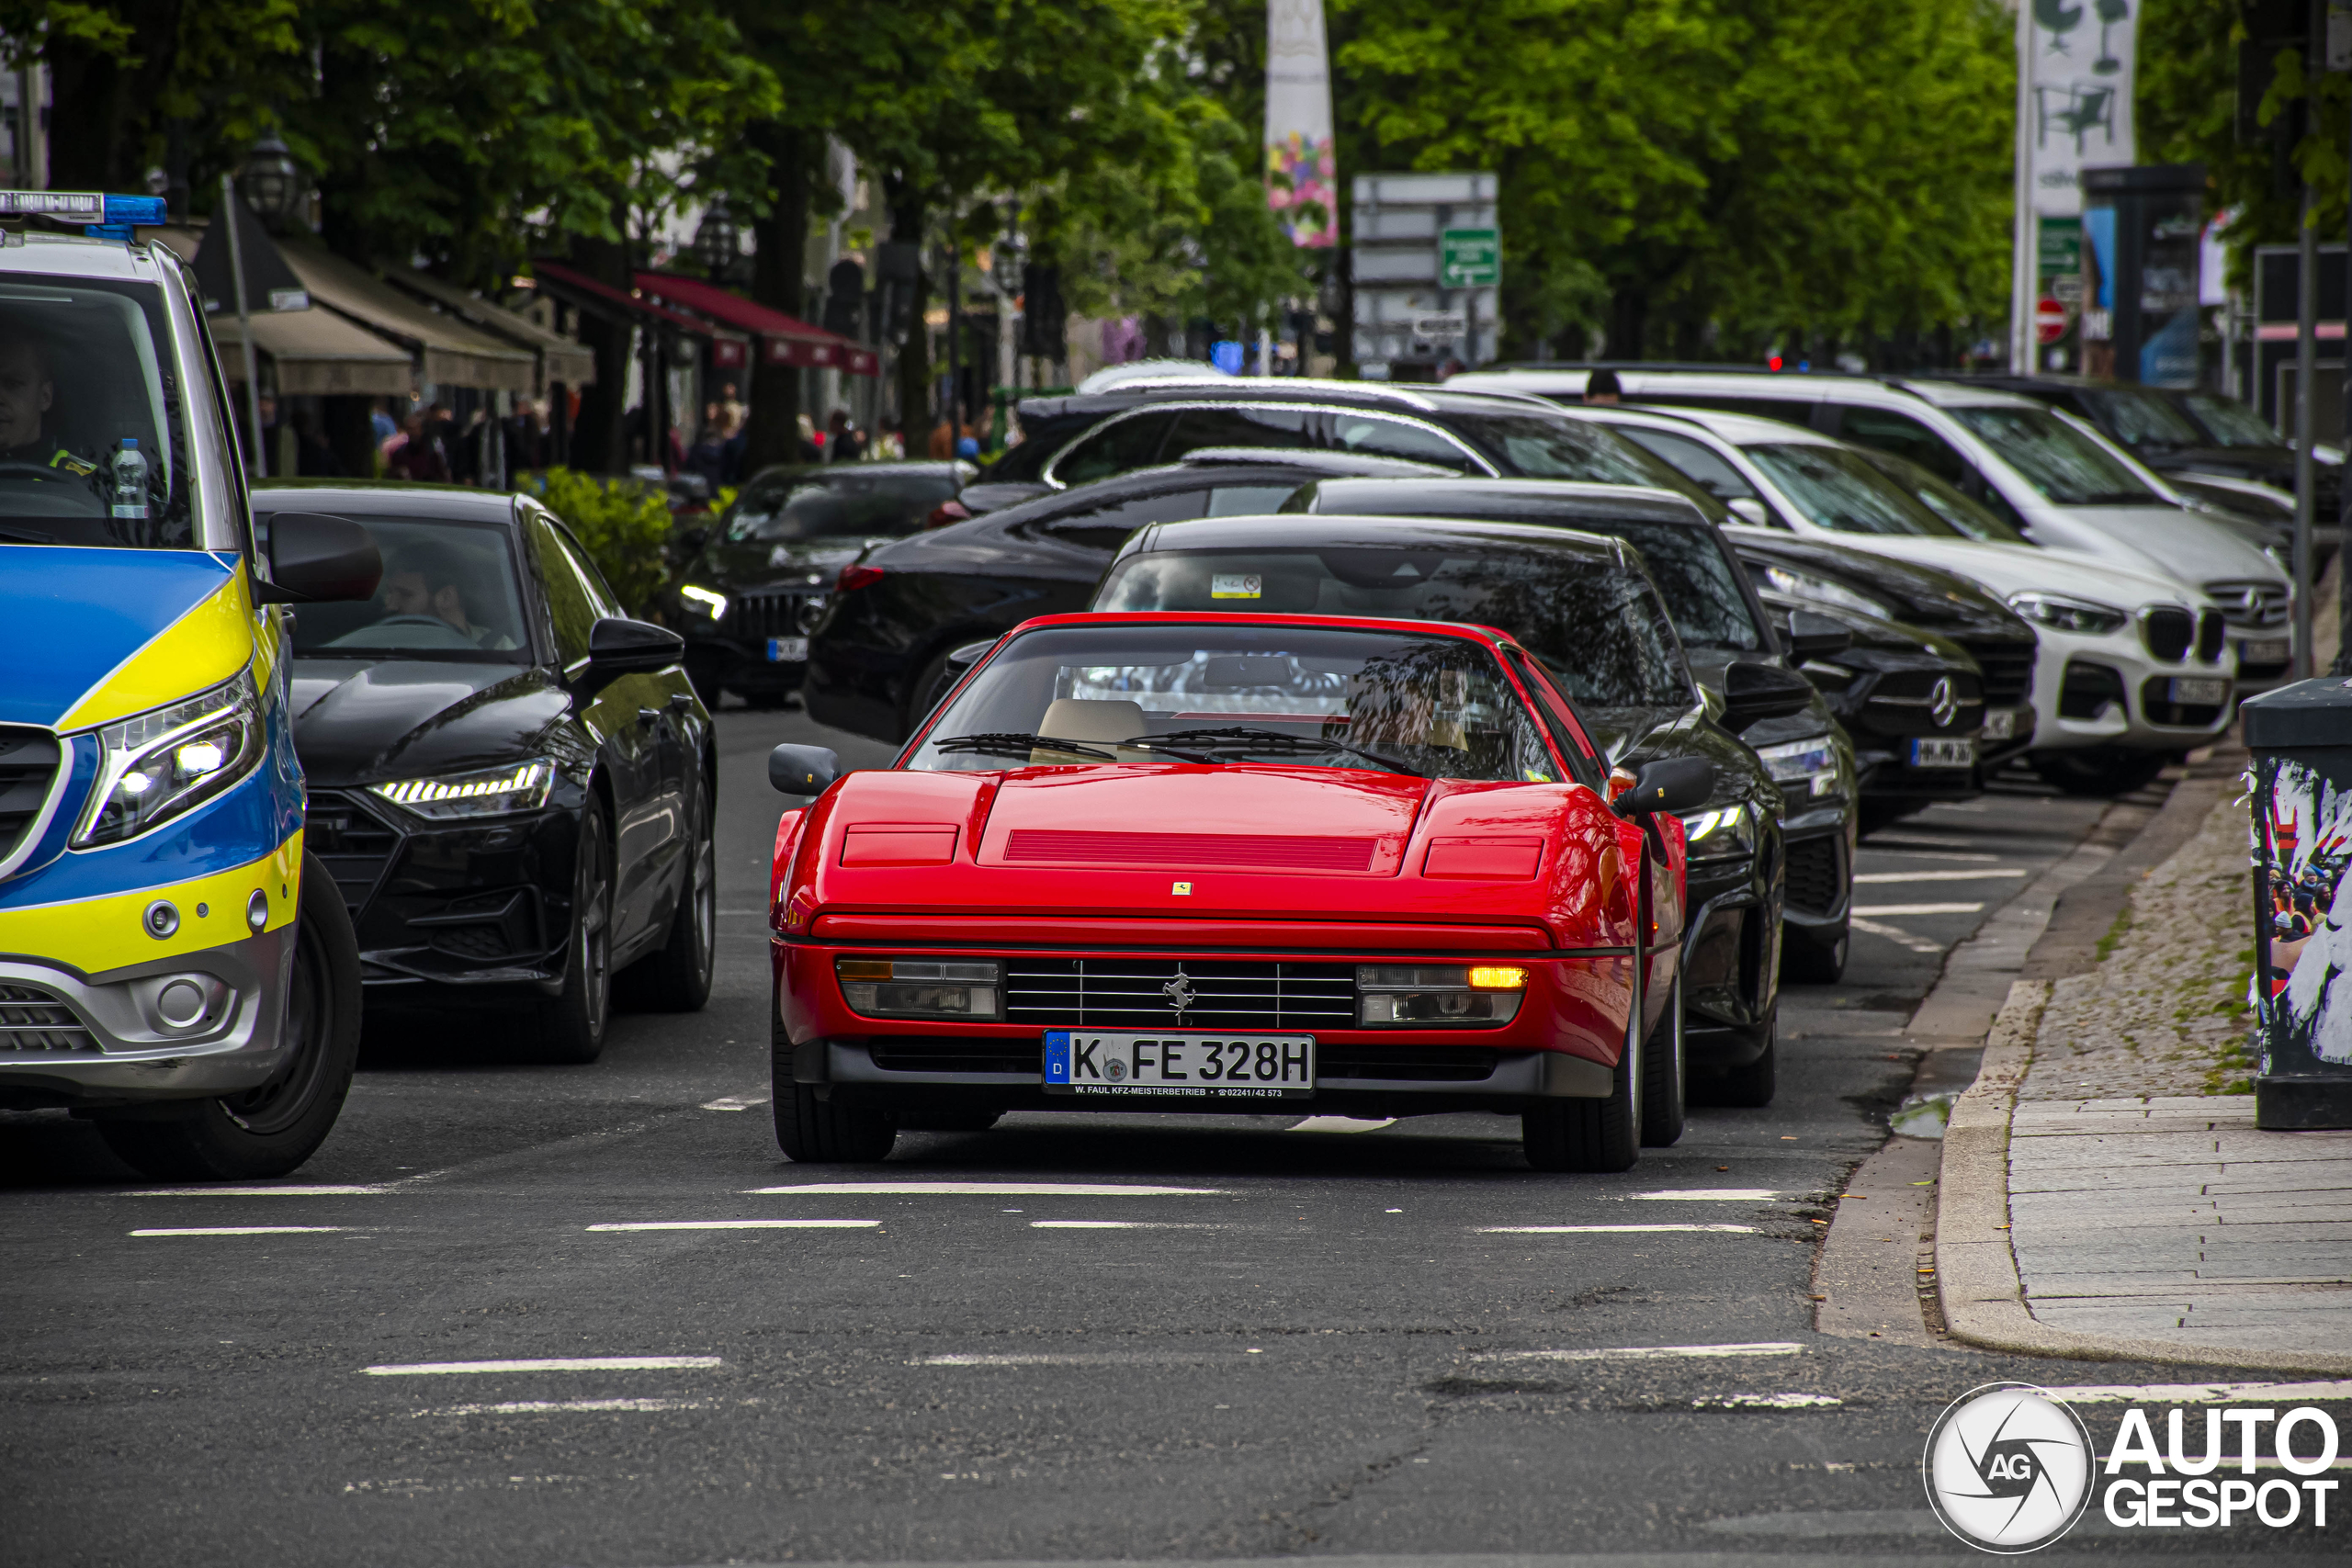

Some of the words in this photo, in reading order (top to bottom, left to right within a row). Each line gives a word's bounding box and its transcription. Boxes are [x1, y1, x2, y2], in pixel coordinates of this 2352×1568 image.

[1073, 1038, 1101, 1078] K
[1132, 1040, 1187, 1080] FE
[1198, 1040, 1308, 1082] 328H
[1088, 1087, 1110, 1095] FAUL
[1112, 1087, 1206, 1096] KFZ-MEISTERBETRIEB
